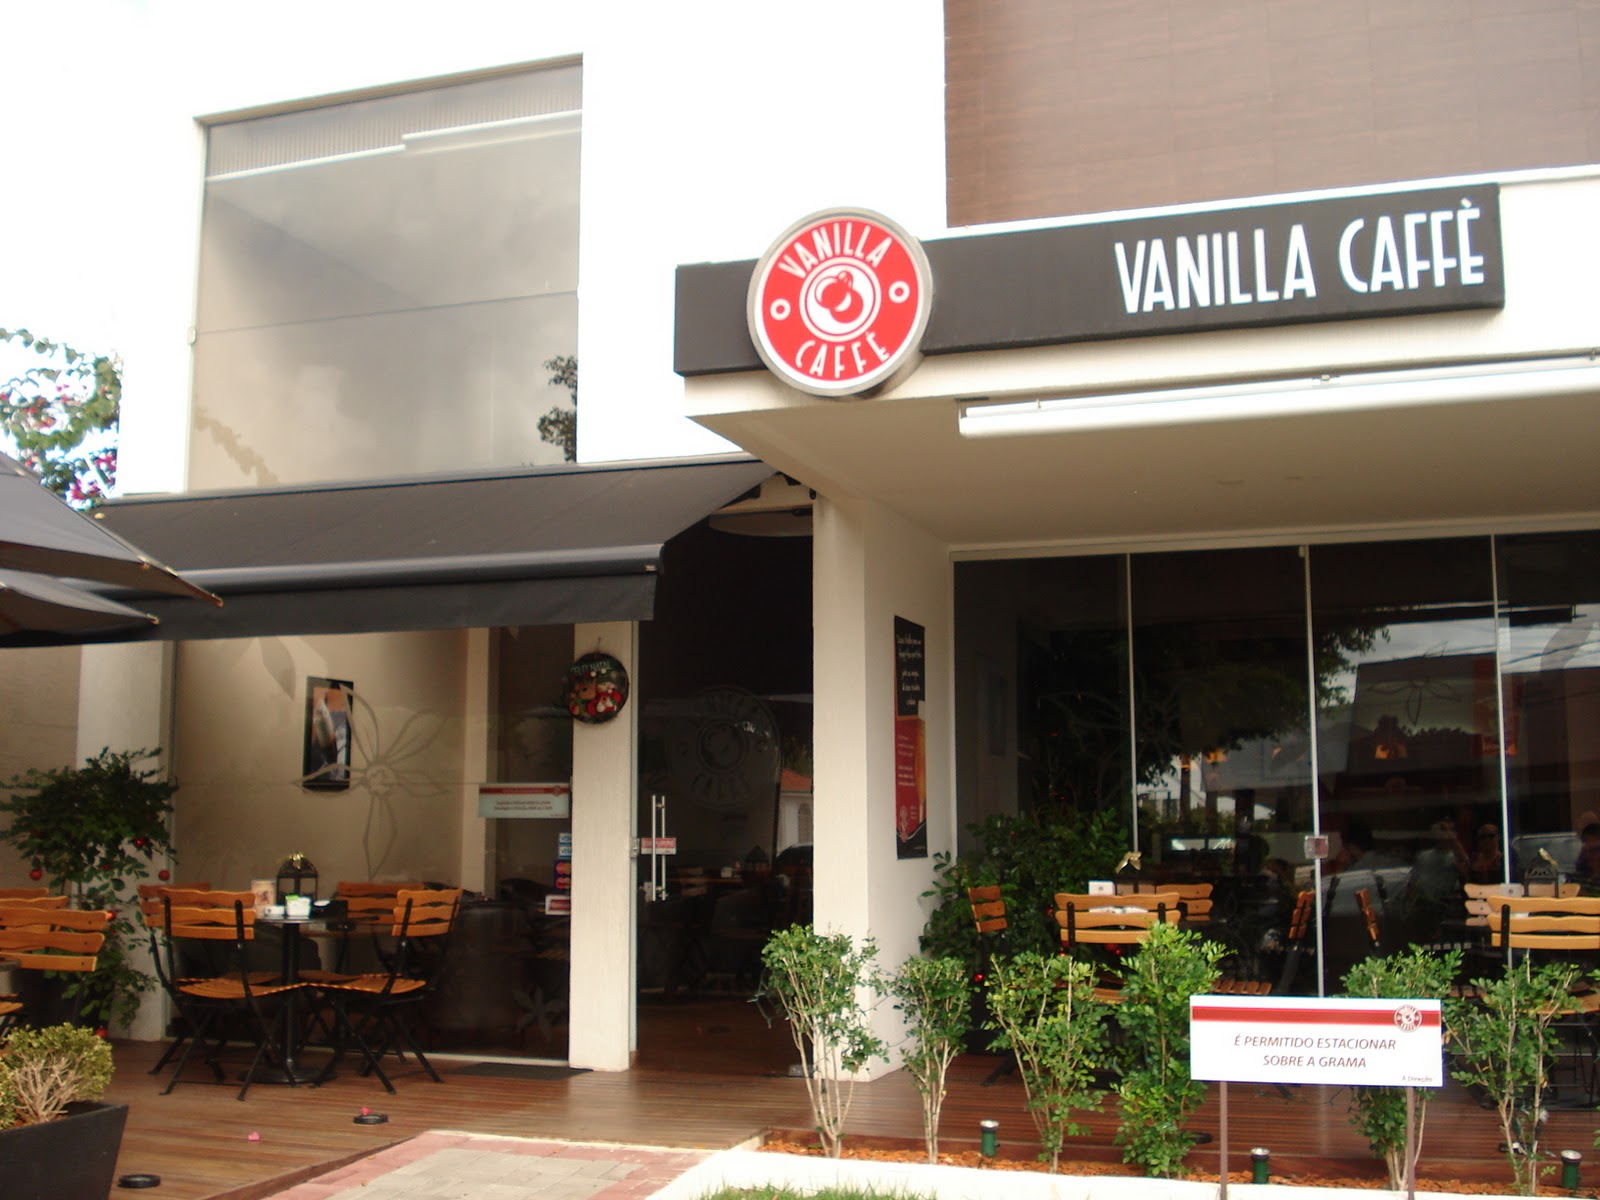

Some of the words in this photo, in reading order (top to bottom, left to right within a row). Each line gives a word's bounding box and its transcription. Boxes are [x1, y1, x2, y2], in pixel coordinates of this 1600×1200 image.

[778, 222, 893, 279] VANILLA
[1114, 224, 1317, 314] VANILLA
[1338, 198, 1485, 293] CAFFÈ
[1234, 1034, 1242, 1046] É
[1244, 1036, 1314, 1048] PERMITIDO
[1317, 1037, 1396, 1050] ESTACIONAR
[1263, 1055, 1304, 1066] SOBRE
[1306, 1056, 1315, 1067] A
[1318, 1056, 1367, 1068] GRAMA
